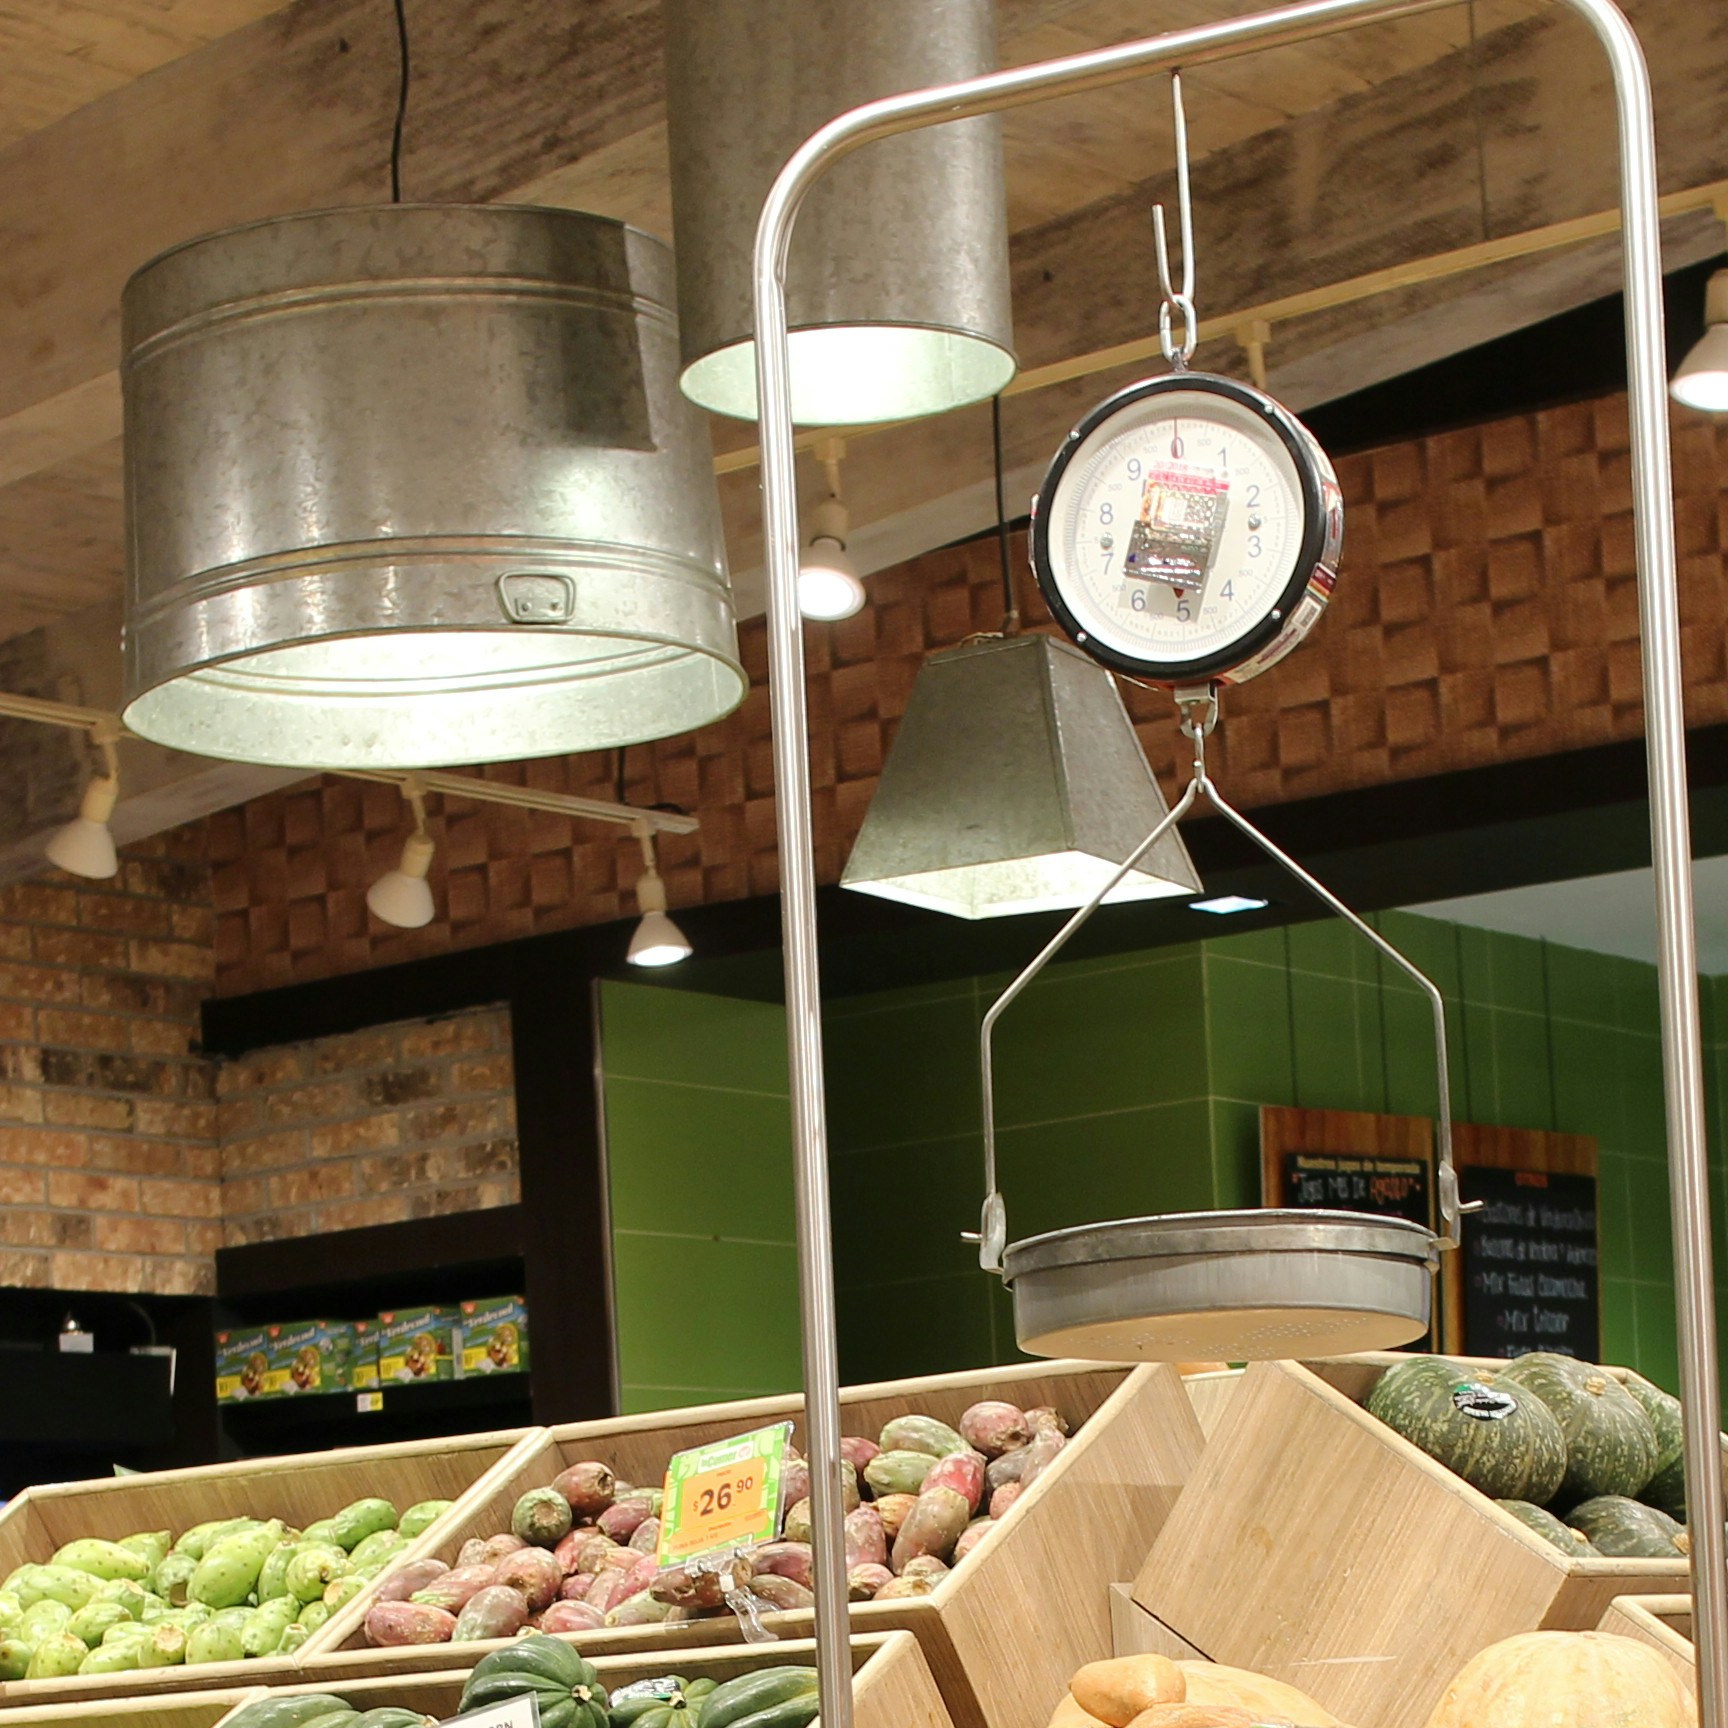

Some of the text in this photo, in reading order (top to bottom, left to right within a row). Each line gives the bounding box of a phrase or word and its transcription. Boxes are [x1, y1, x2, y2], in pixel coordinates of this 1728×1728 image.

[1127, 458, 1141, 480] 9
[1217, 447, 1227, 468] 1
[1246, 484, 1261, 508] 2
[1100, 502, 1113, 525] 8
[1248, 535, 1262, 558] 3
[1100, 552, 1114, 575] 7
[1131, 589, 1146, 612] 6
[1219, 578, 1234, 601] 4
[1176, 600, 1190, 622] 5
